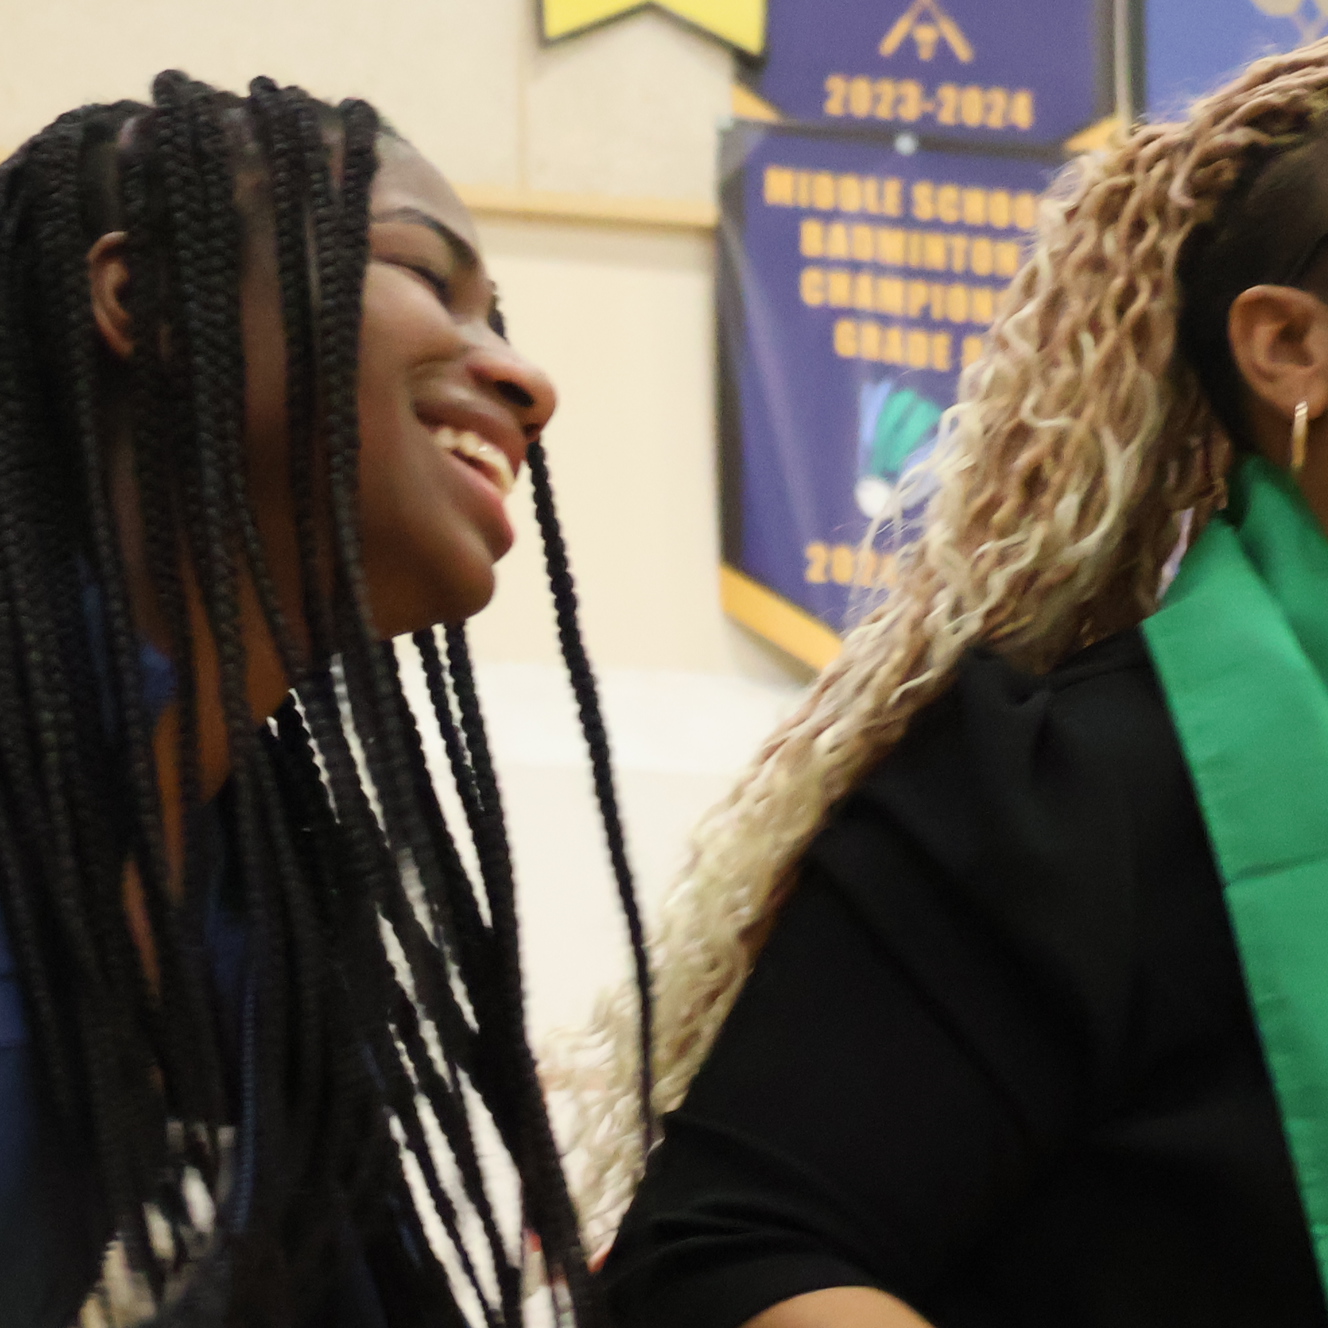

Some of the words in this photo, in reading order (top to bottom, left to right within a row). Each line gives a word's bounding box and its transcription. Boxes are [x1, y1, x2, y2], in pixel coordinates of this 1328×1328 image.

[824, 74, 1034, 131] 2023-2024
[764, 165, 904, 218] MIDDLE
[912, 180, 1039, 231] SCHOO
[799, 217, 1021, 278] BADMINTON
[833, 317, 952, 372] GRADE
